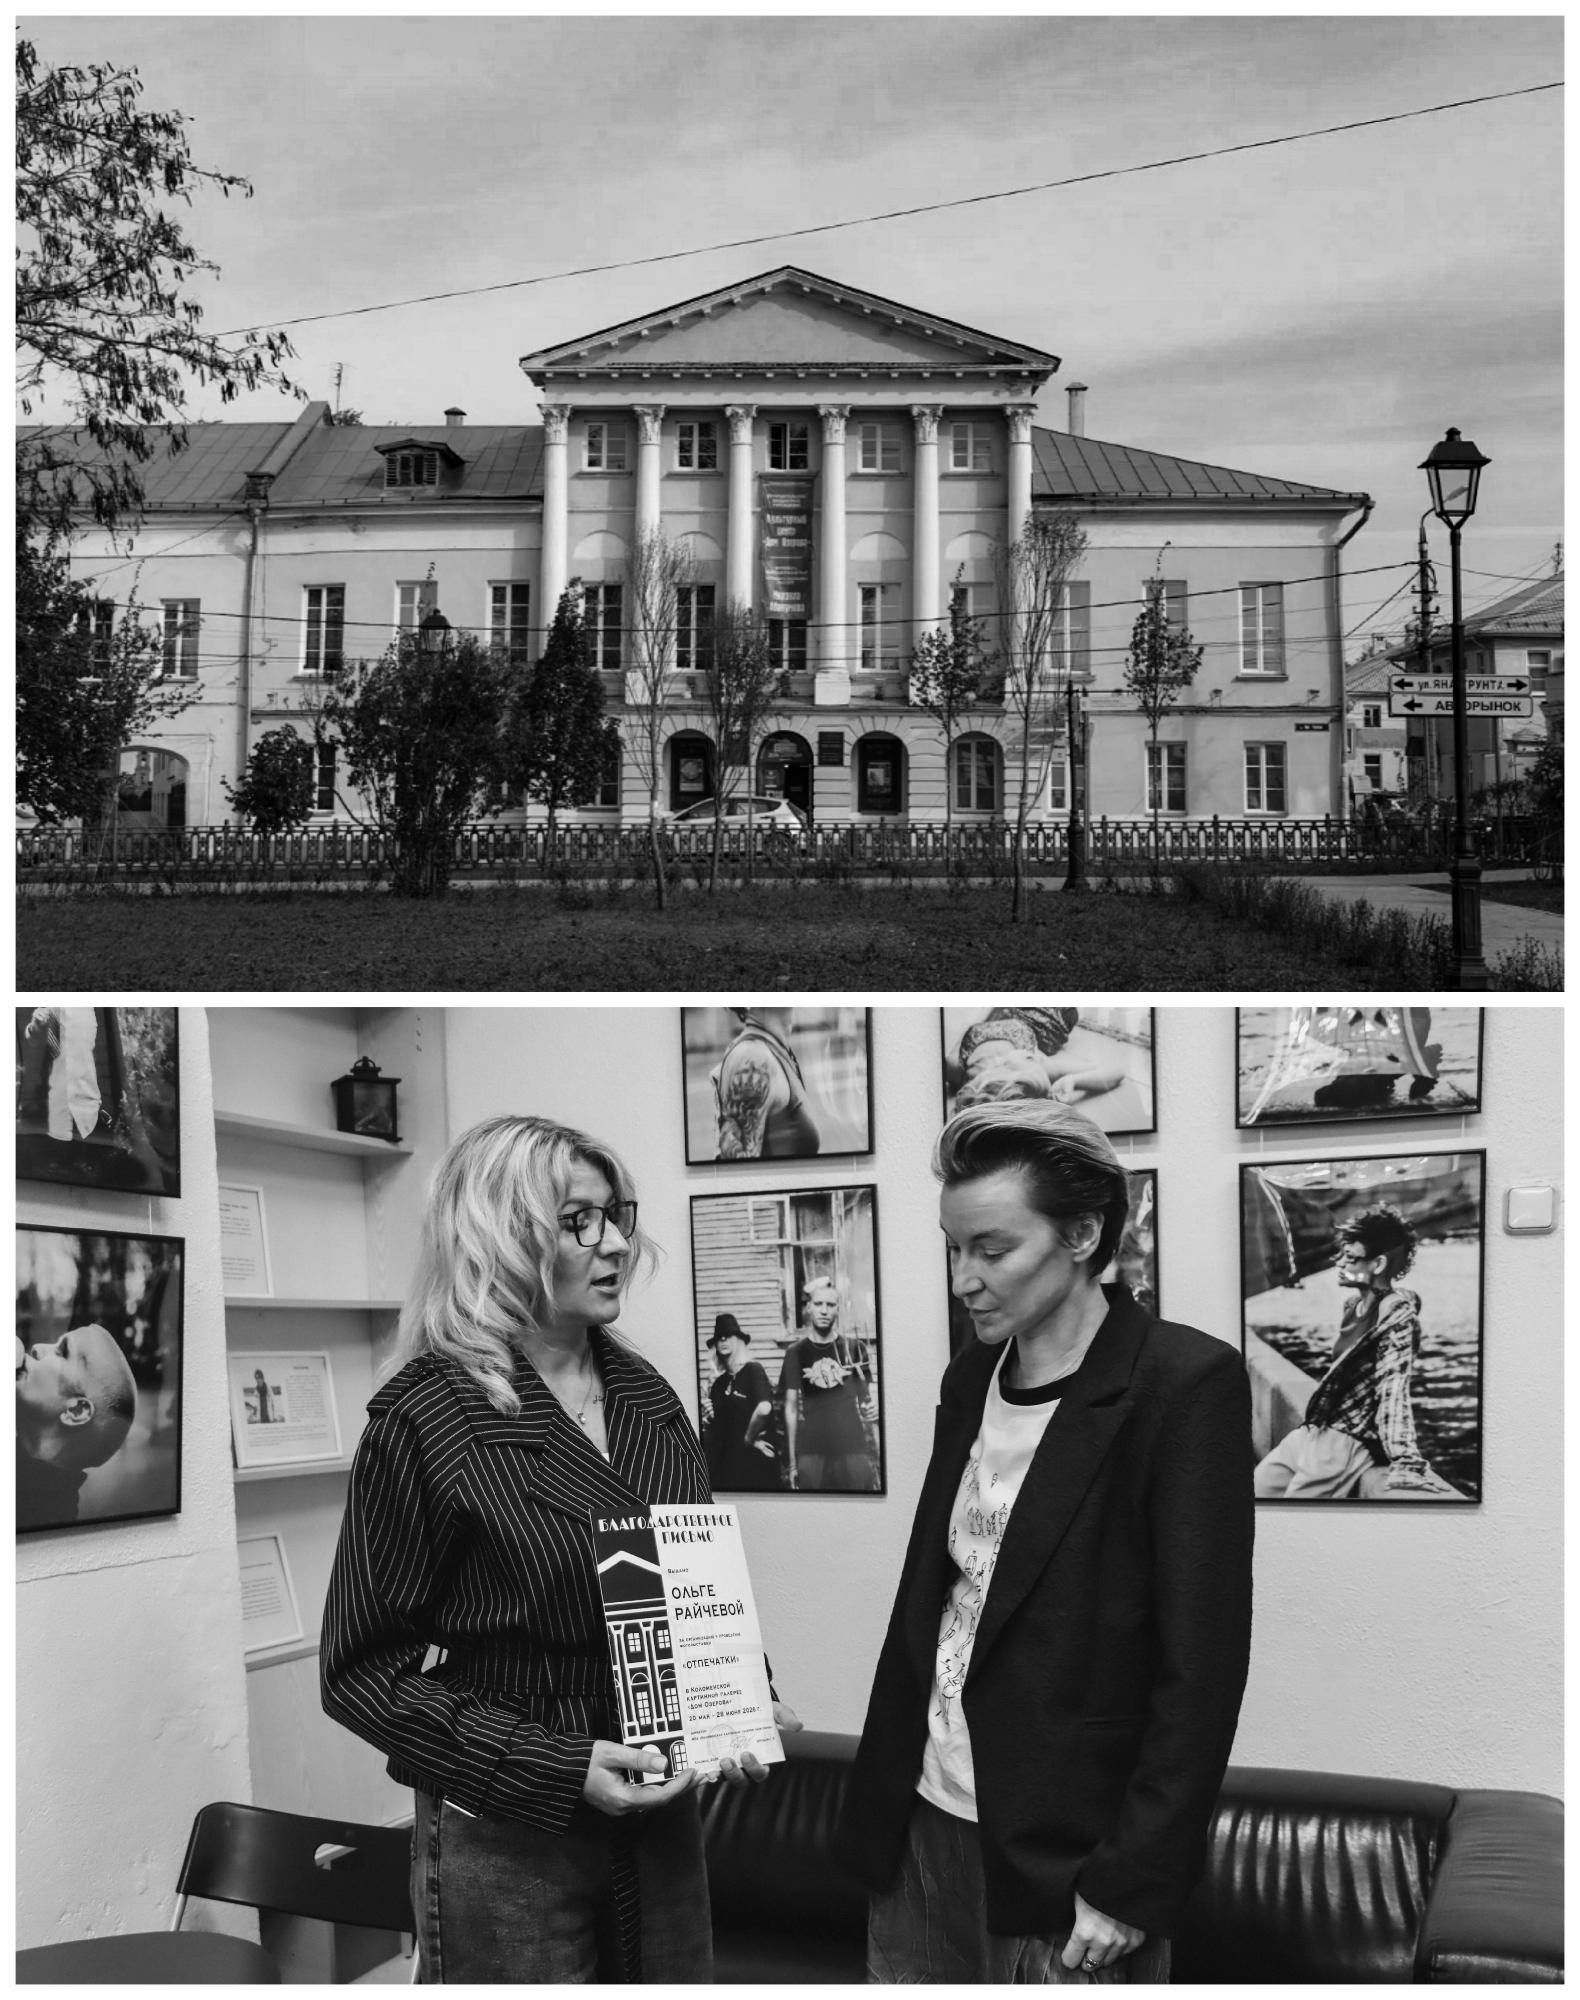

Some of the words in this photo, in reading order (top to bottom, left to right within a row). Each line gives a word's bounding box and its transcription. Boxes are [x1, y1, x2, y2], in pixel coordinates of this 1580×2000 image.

[1468, 679, 1505, 690] РУНТА
[1435, 701, 1522, 712] АВОРЫНОК
[598, 1514, 734, 1532] БЛАГОДАРСТВЕННОЕ
[662, 1530, 715, 1544] ПИСЬМО
[672, 1584, 716, 1599] ОЛЬГЕ
[675, 1600, 744, 1620] РАЙЧЕВОЙ
[682, 1655, 740, 1669] «ОТПЕЧАТКИ»
